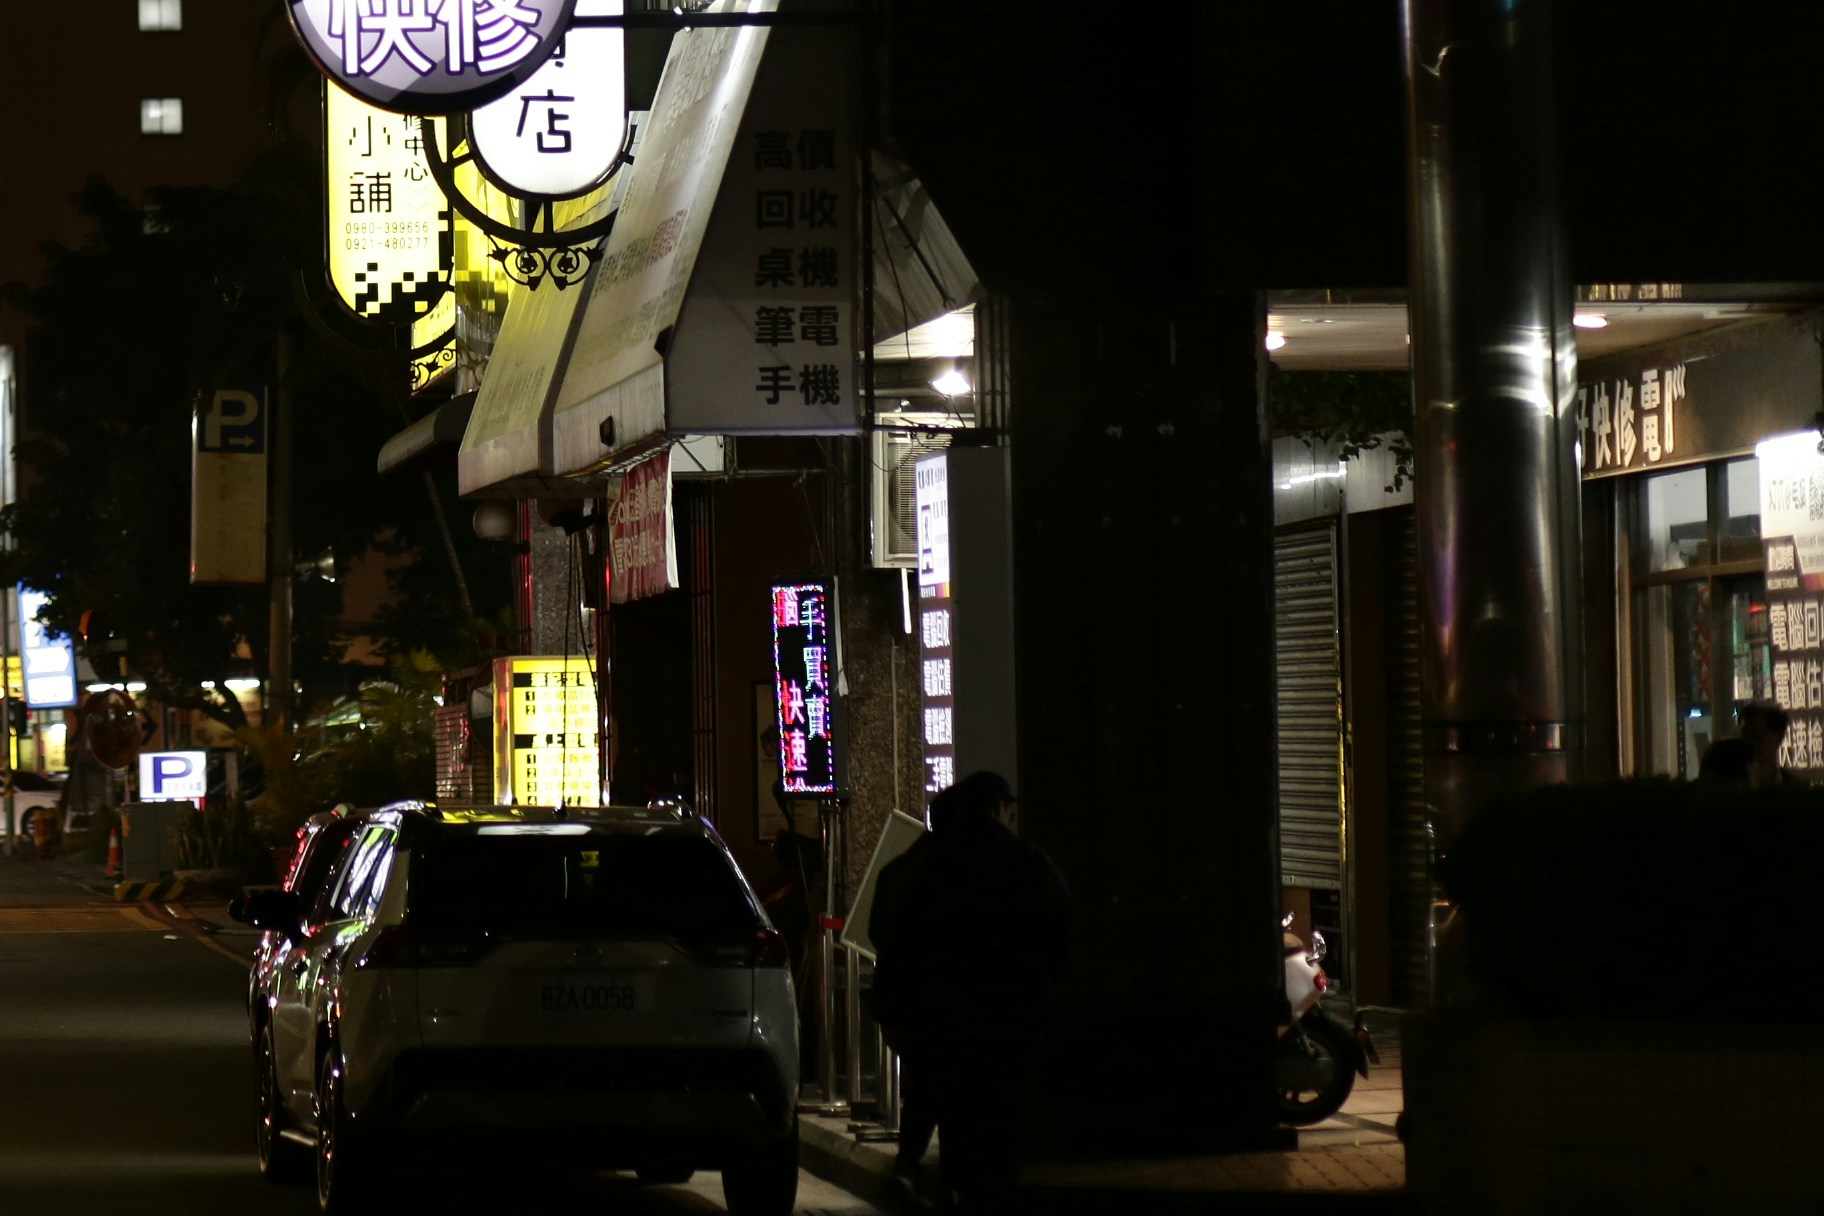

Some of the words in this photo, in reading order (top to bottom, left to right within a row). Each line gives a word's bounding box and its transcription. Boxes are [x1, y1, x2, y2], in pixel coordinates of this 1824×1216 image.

[754, 129, 837, 172] 高價
[755, 188, 840, 230] 回收
[755, 246, 840, 289] 桌機
[755, 305, 841, 347] 筆電
[755, 364, 842, 406] 手機
[204, 390, 259, 448] P
[1770, 601, 1824, 653] 電腦回
[153, 756, 193, 794] P
